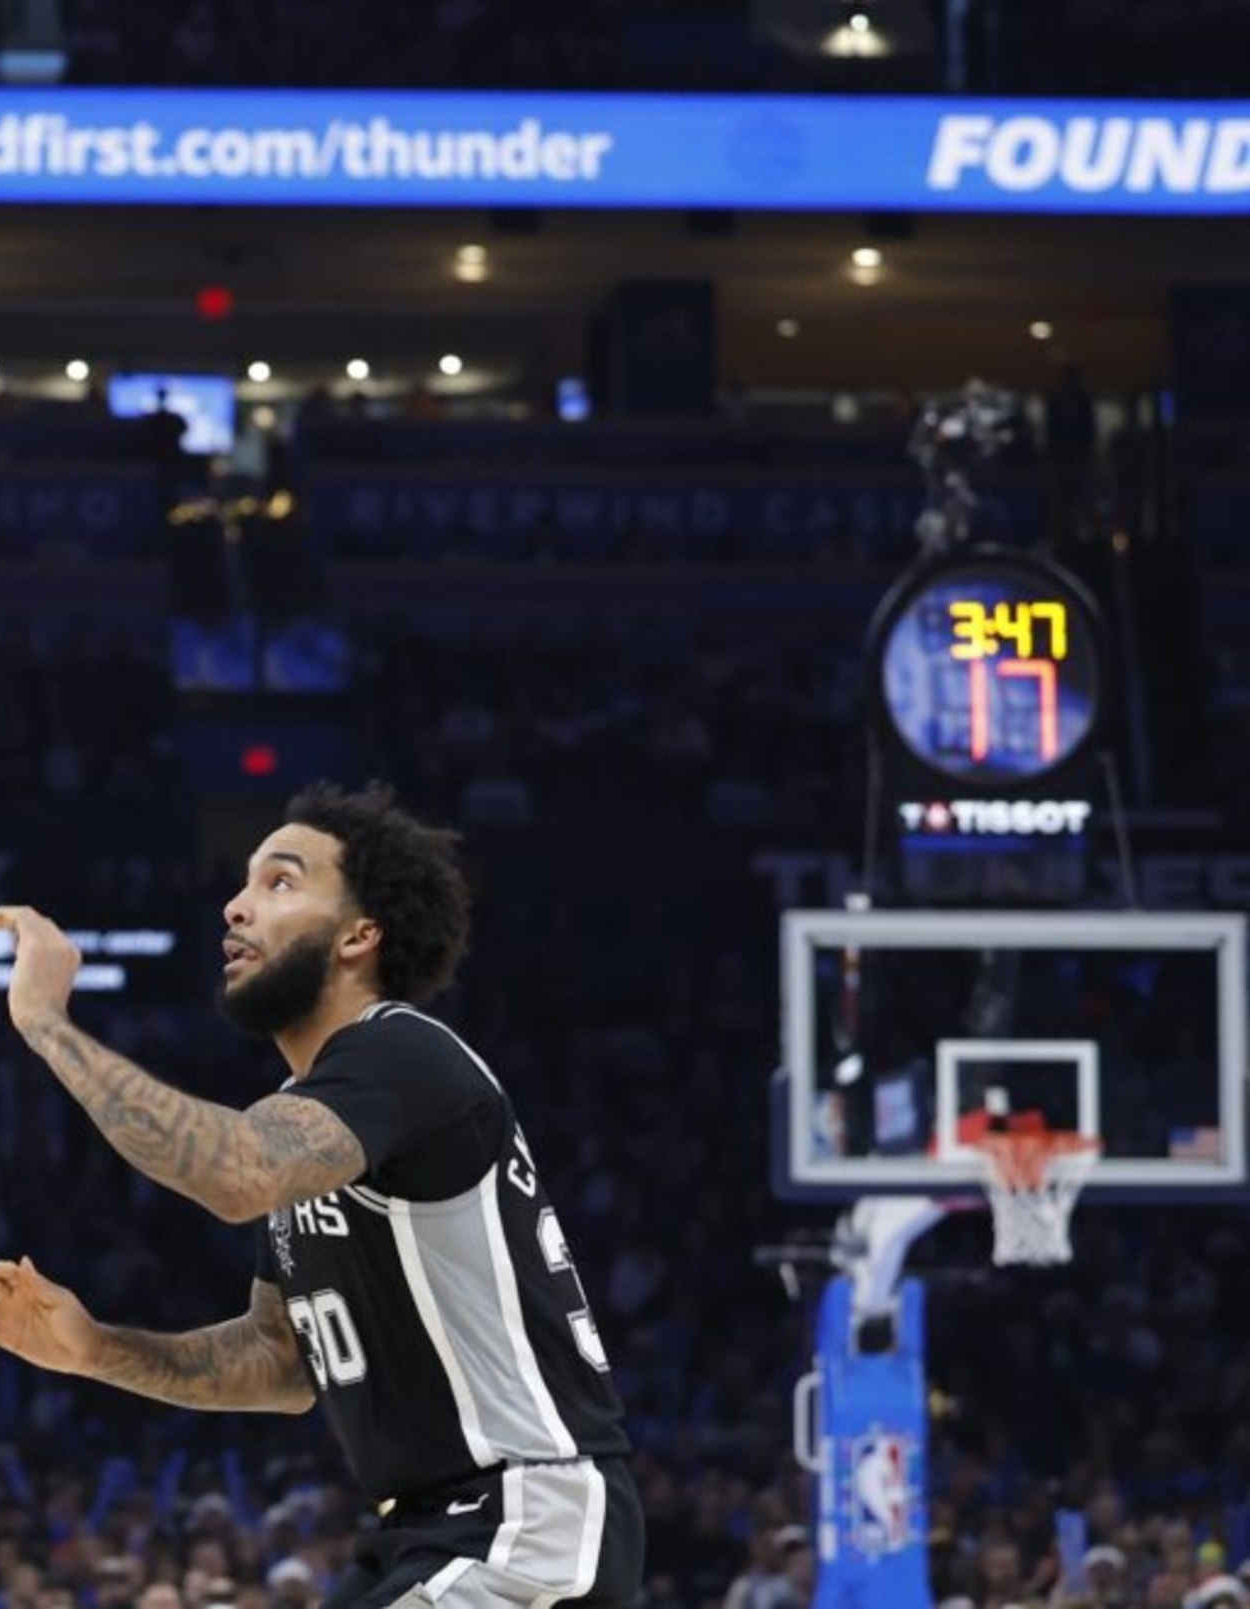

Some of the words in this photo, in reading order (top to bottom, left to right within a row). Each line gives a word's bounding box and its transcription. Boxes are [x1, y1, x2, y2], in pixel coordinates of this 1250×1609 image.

[949, 601, 1068, 660] 3:47
[969, 658, 1059, 765] 17
[951, 800, 1091, 834] TISSOT
[286, 1288, 368, 1391] 30
